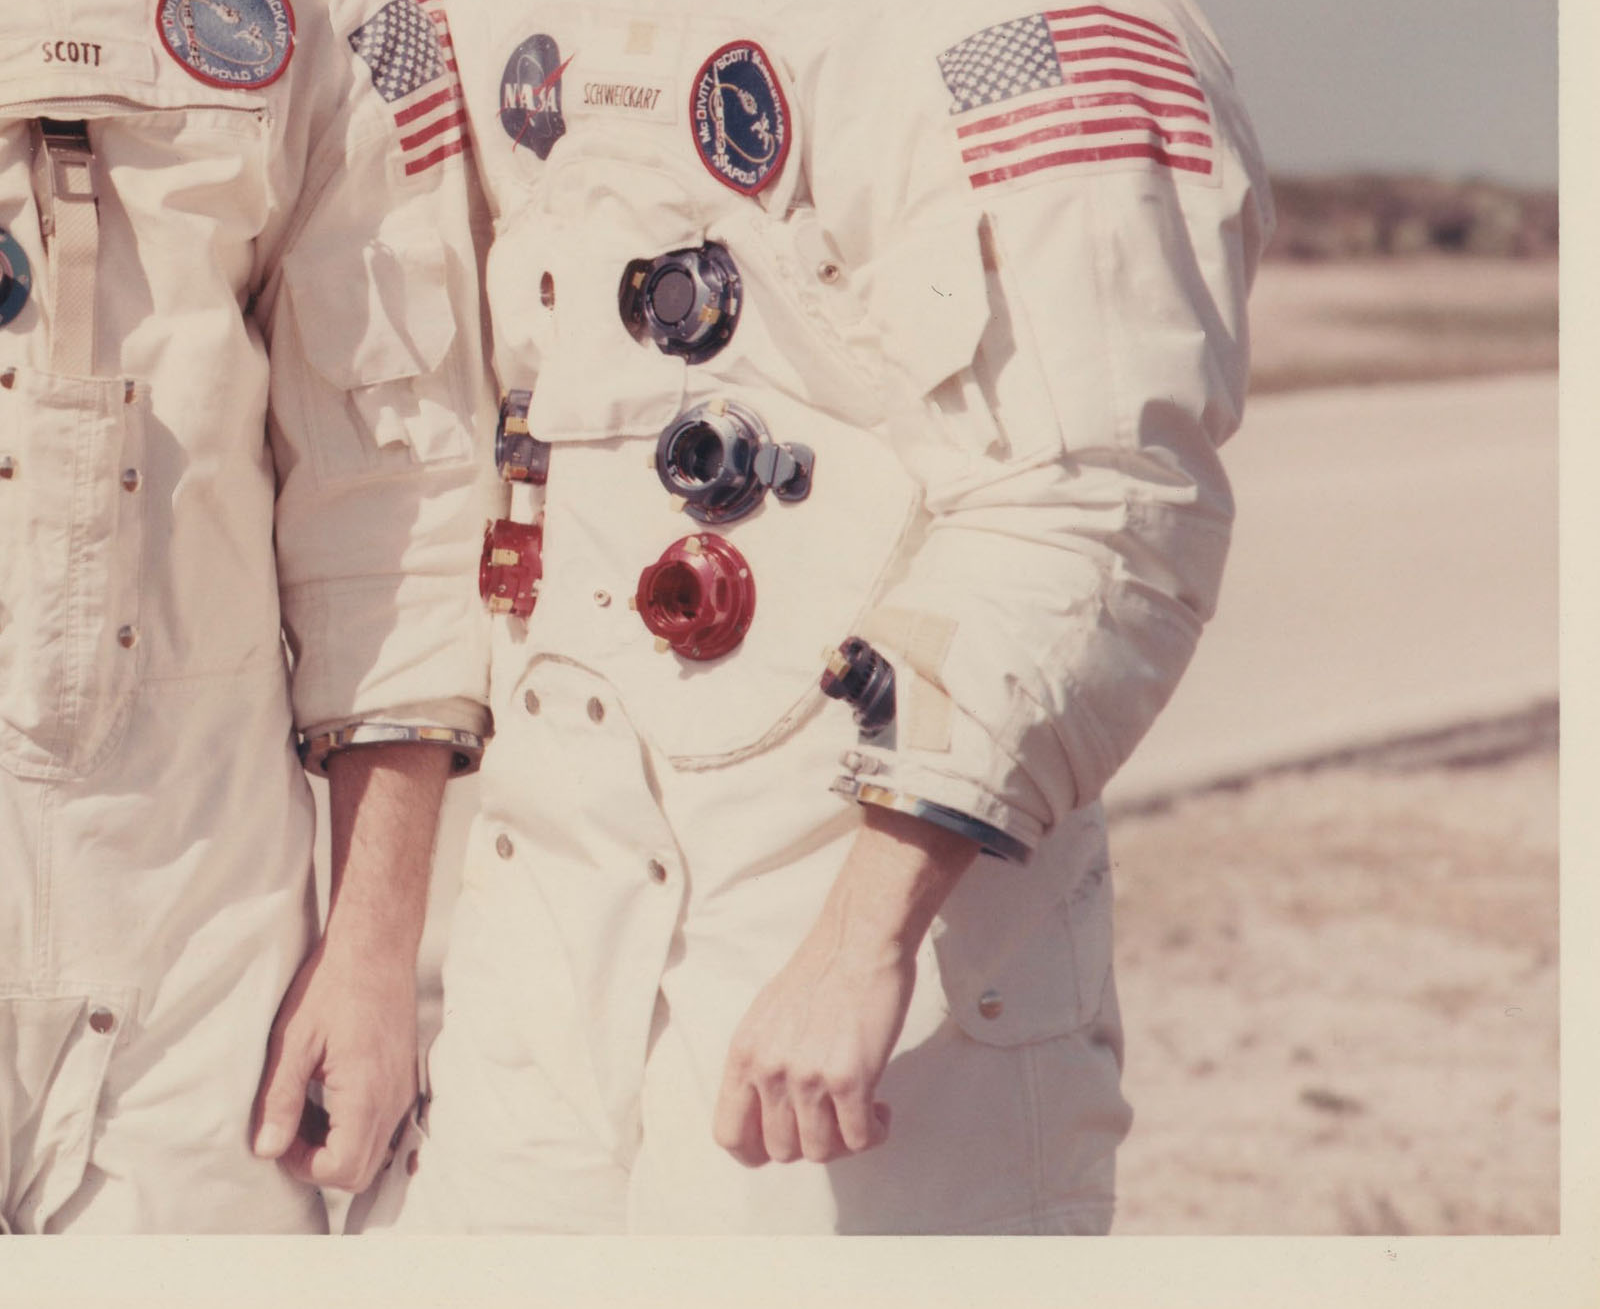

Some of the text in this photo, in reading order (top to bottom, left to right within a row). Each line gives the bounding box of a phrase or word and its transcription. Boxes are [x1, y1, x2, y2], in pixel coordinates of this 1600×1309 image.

[42, 40, 102, 67] SCOTT
[717, 48, 750, 71] SCOTT
[504, 83, 559, 113] NASA
[584, 82, 662, 110] SCHWEICKART
